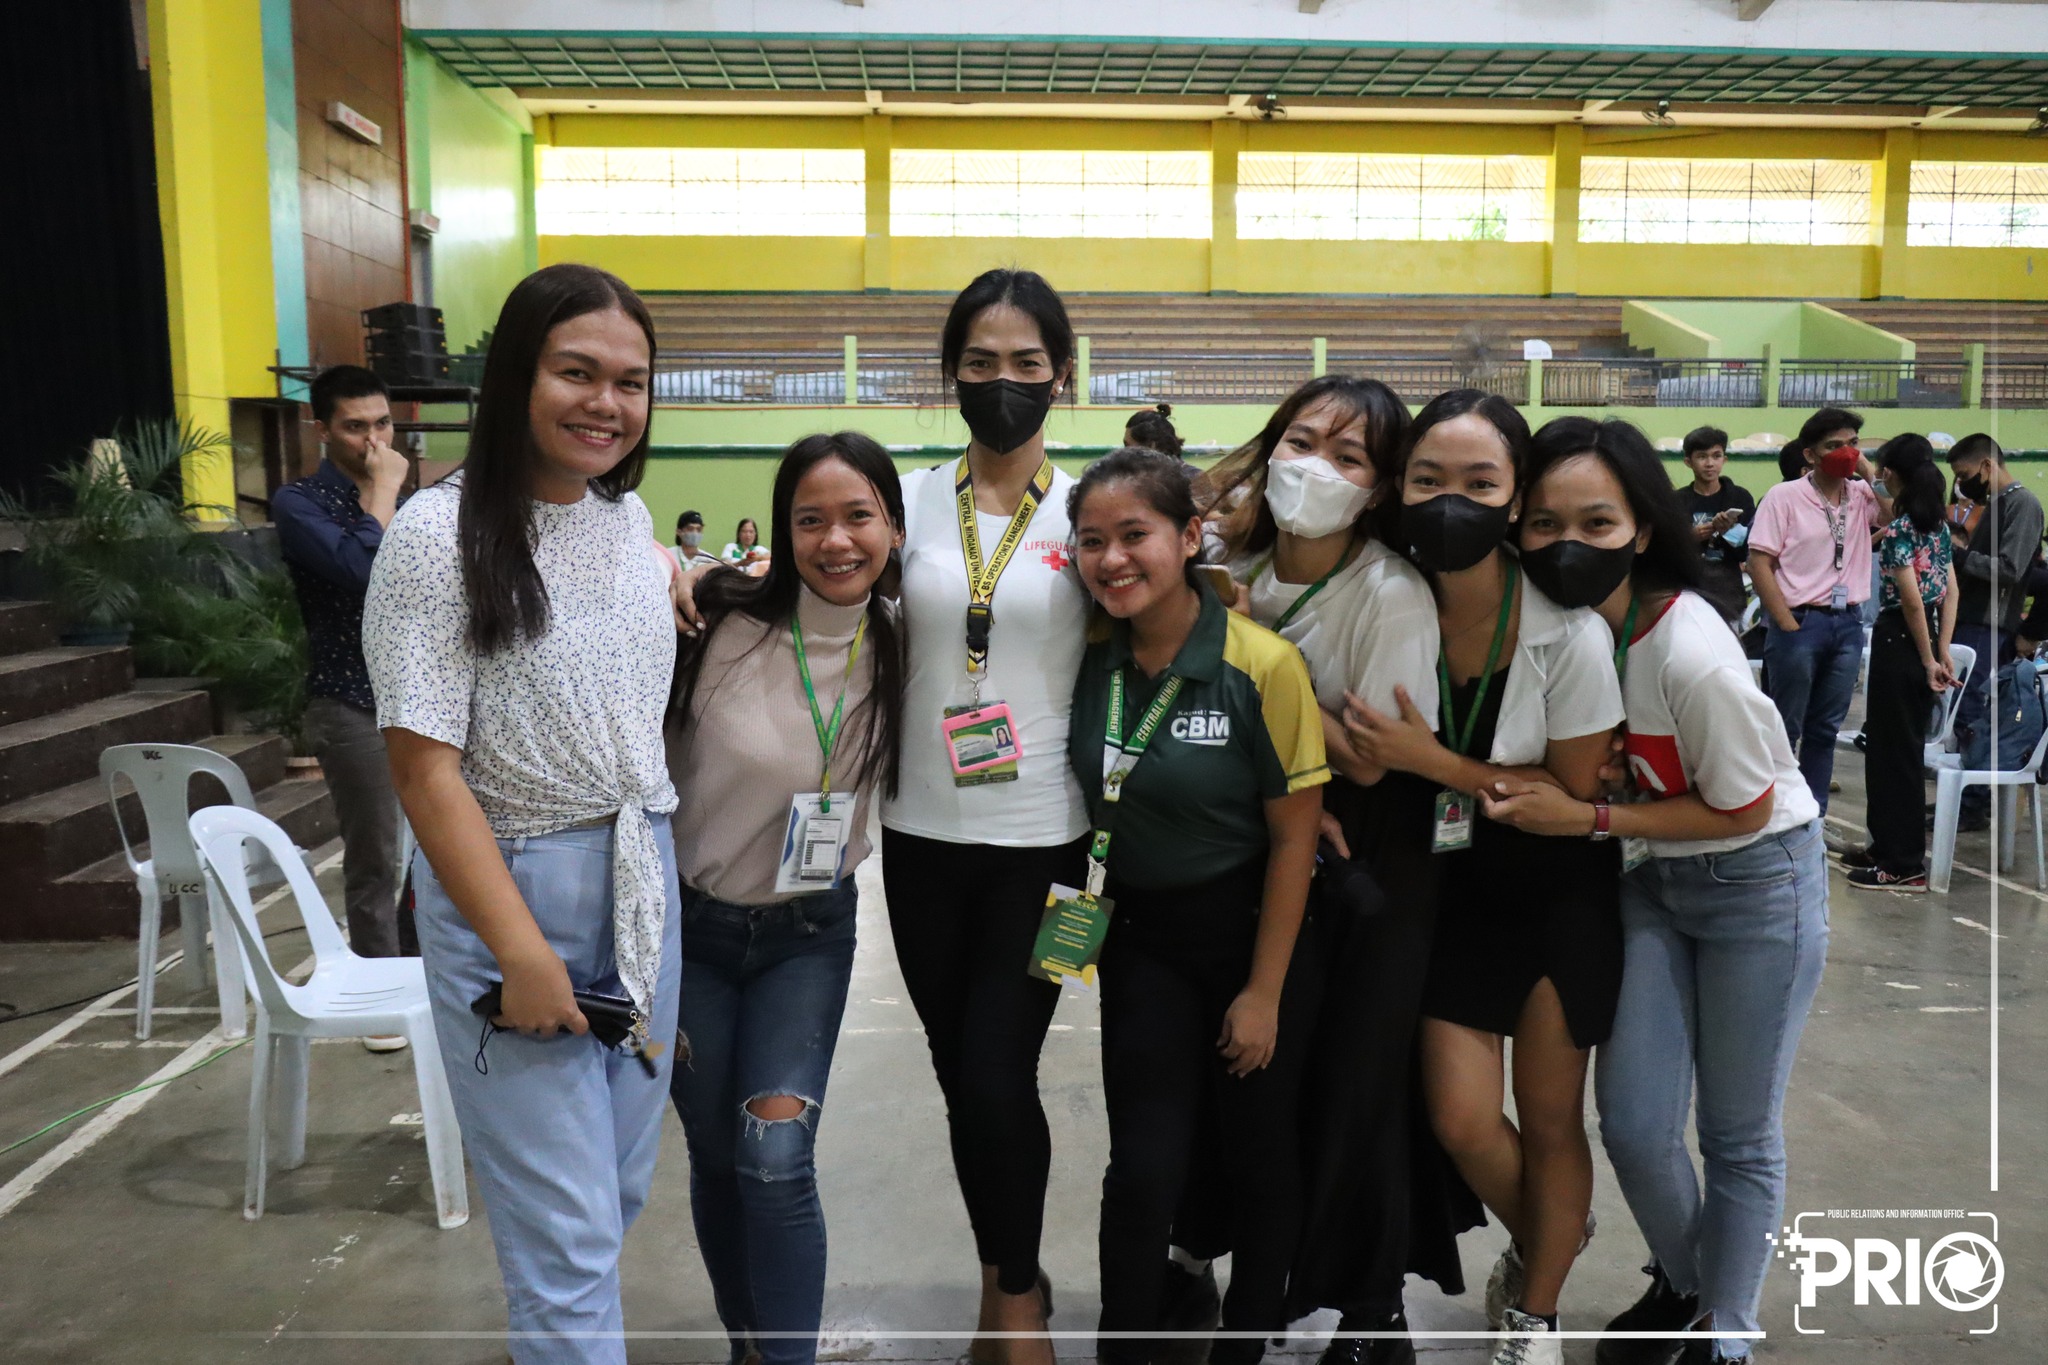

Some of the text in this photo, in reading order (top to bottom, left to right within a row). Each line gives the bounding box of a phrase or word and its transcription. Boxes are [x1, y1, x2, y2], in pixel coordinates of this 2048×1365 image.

[960, 492, 982, 588] CENTRAL MINDANAO UNIVE
[1025, 540, 1078, 556] LIFEGUAR
[986, 543, 1012, 580] OPERATIONS
[981, 580, 992, 591] BS
[1109, 685, 1121, 735] MANAGEMENT
[1136, 674, 1182, 742] CENTRAL MINDA
[1170, 716, 1230, 739] CBM
[169, 883, 200, 894] UCC
